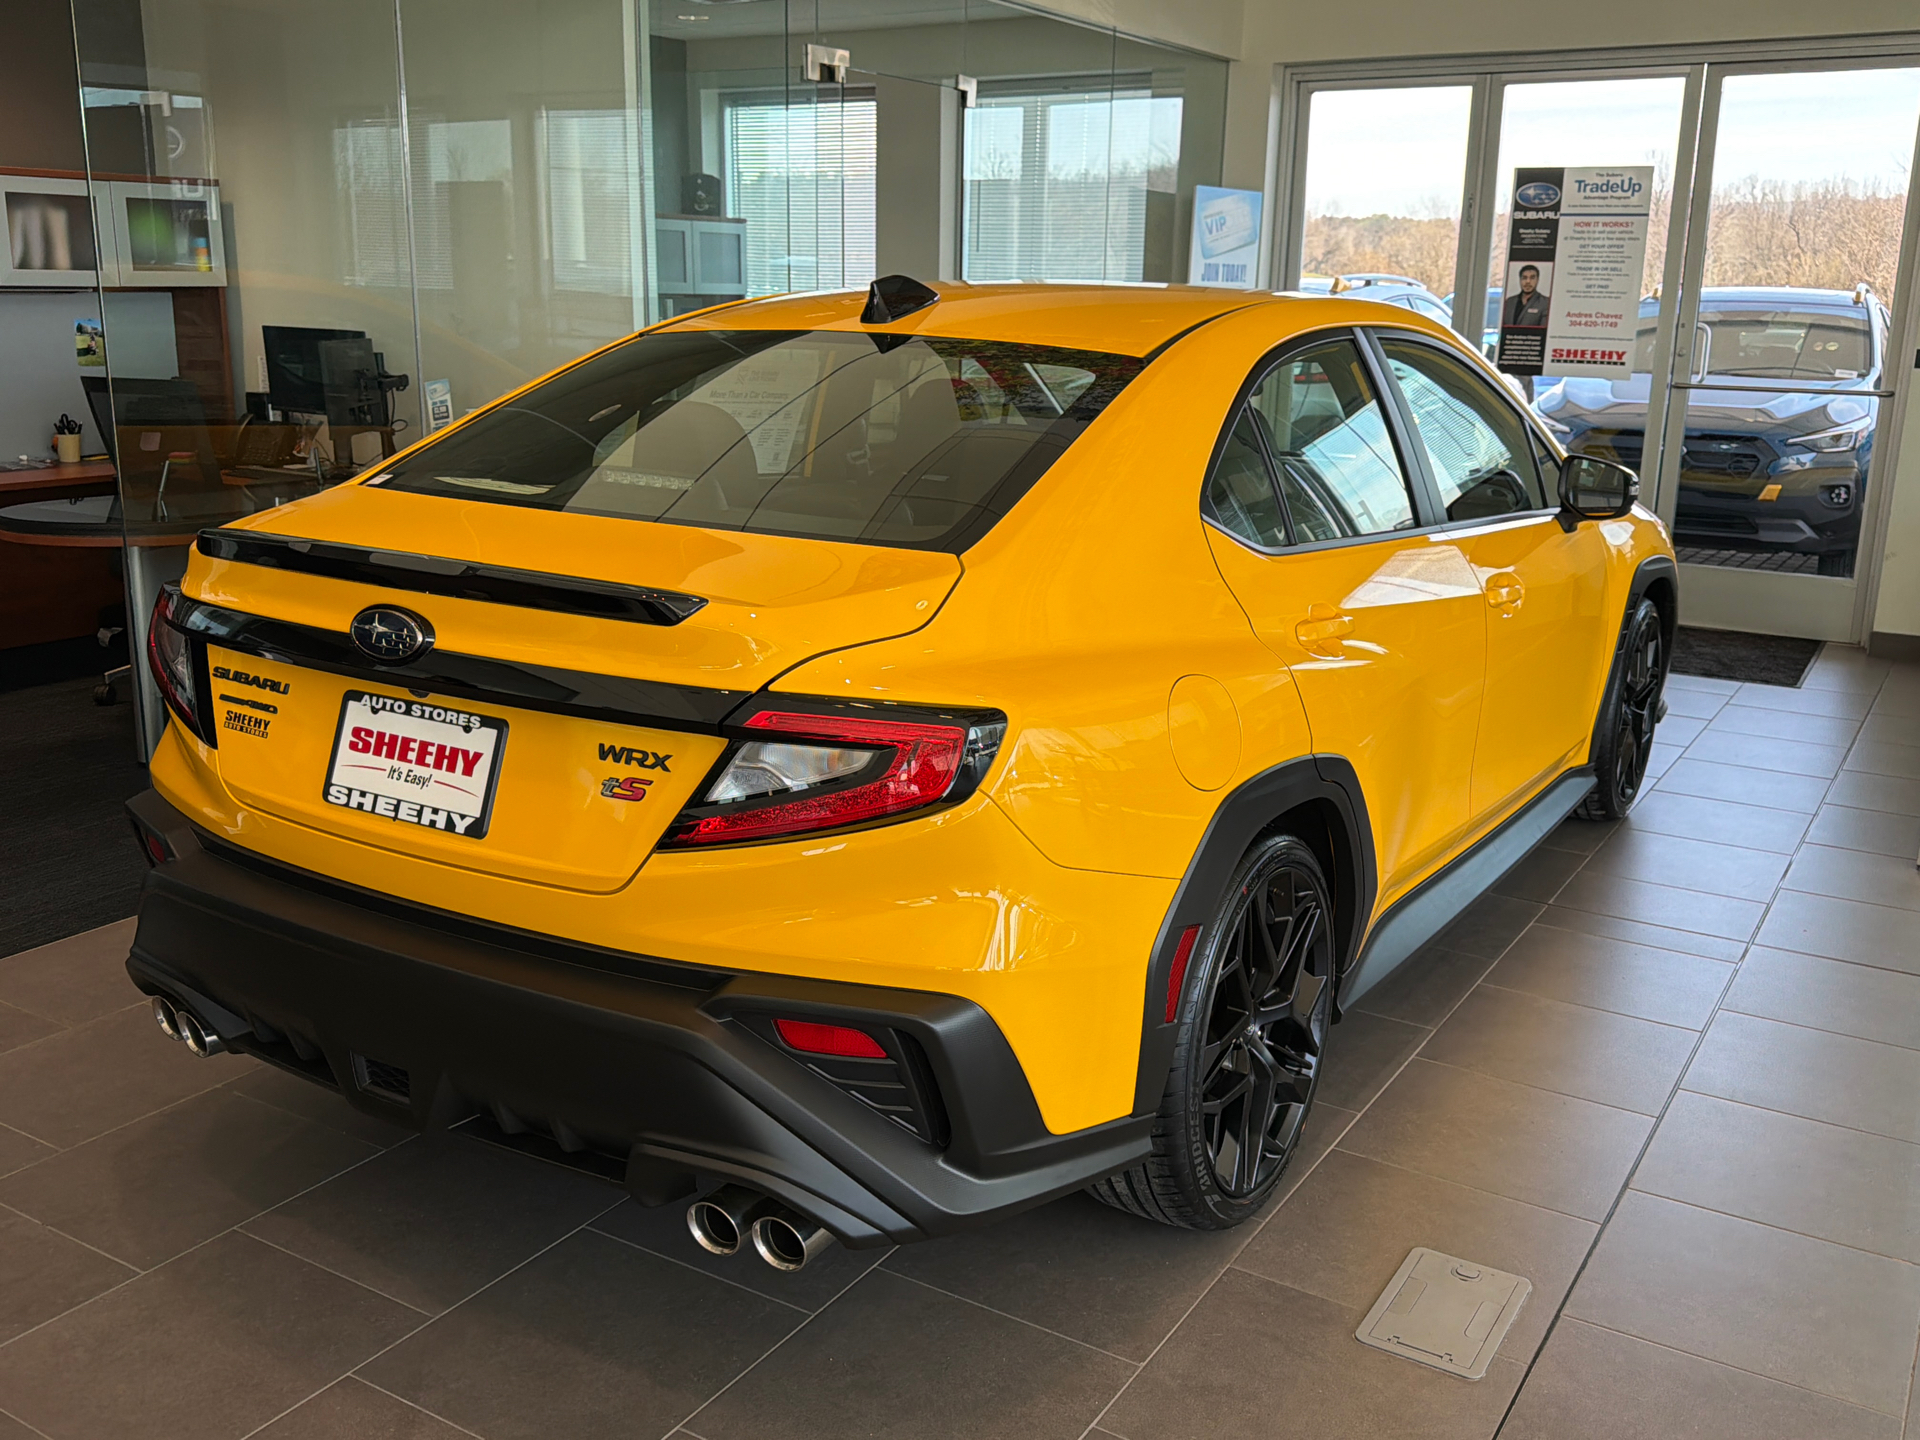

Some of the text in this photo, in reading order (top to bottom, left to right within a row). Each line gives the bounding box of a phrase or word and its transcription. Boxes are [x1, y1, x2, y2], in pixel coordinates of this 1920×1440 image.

[1574, 176, 1642, 197] TradeUp
[1204, 215, 1227, 235] VIP
[1513, 211, 1560, 219] SUBARU
[1201, 262, 1247, 283] JOIN TODAY!
[1565, 311, 1623, 320] Andres Chavez
[1568, 320, 1618, 328] 304-620-1749
[1551, 348, 1627, 361] SHEEHY
[212, 665, 290, 695] SUBARU
[225, 709, 271, 731] SHEEHY
[360, 694, 482, 729] AUTO STORES
[348, 726, 484, 777] SHEEHY
[598, 742, 674, 773] WRX
[387, 765, 433, 790] It's Easy!
[327, 785, 476, 834] SHEEHY
